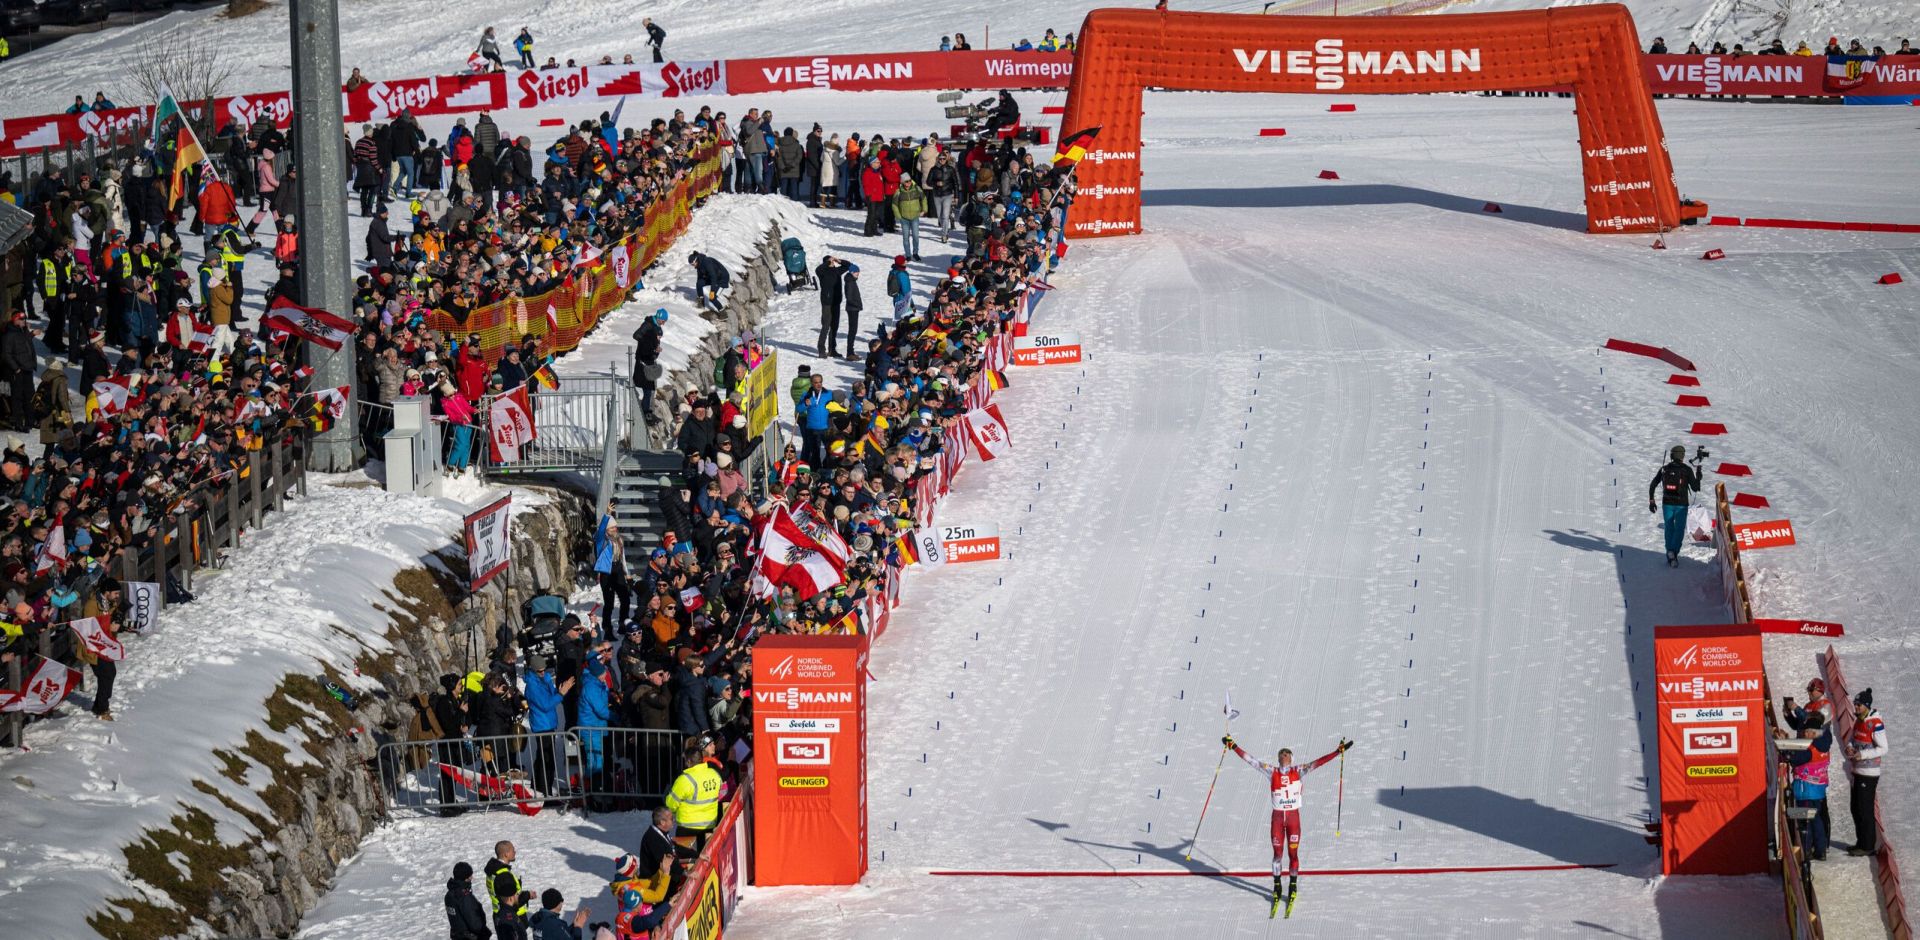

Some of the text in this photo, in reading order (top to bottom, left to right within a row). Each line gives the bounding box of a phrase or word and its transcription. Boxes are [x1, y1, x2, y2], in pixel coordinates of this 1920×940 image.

[1232, 38, 1481, 90] VIESSMANN
[661, 60, 721, 98] Stiegl
[761, 57, 913, 90] VIESSMANN
[1656, 56, 1803, 93] VIESSMANN
[518, 66, 590, 108] Stiegl
[368, 75, 439, 120] Stiegl
[1084, 149, 1136, 164] IESSMANN
[1586, 145, 1648, 161] VIESSMANN
[1076, 184, 1136, 199] VIESSMANN
[1590, 180, 1651, 196] VIESSMANN
[1075, 219, 1135, 234] VIESSMANN
[1595, 215, 1656, 231] VIESSMANN
[1034, 335, 1060, 347] 50m
[1017, 349, 1078, 364] VIESSMANN
[944, 526, 976, 540] 25m
[1735, 528, 1791, 546] ESSMANN
[945, 543, 996, 561] SSMANN
[1800, 622, 1828, 634] Seefeld
[797, 657, 823, 665] NORDIC
[1660, 676, 1759, 699] VIESSMANN
[755, 687, 852, 710] VIESSMANN
[1695, 709, 1724, 718] Seefeld
[788, 719, 816, 729] Seefeld
[1695, 735, 1727, 747] Tirol
[788, 745, 820, 758] Tirol
[1689, 767, 1734, 775] PALFINGER
[782, 778, 826, 786] PALFINGER
[1284, 789, 1289, 799] 1
